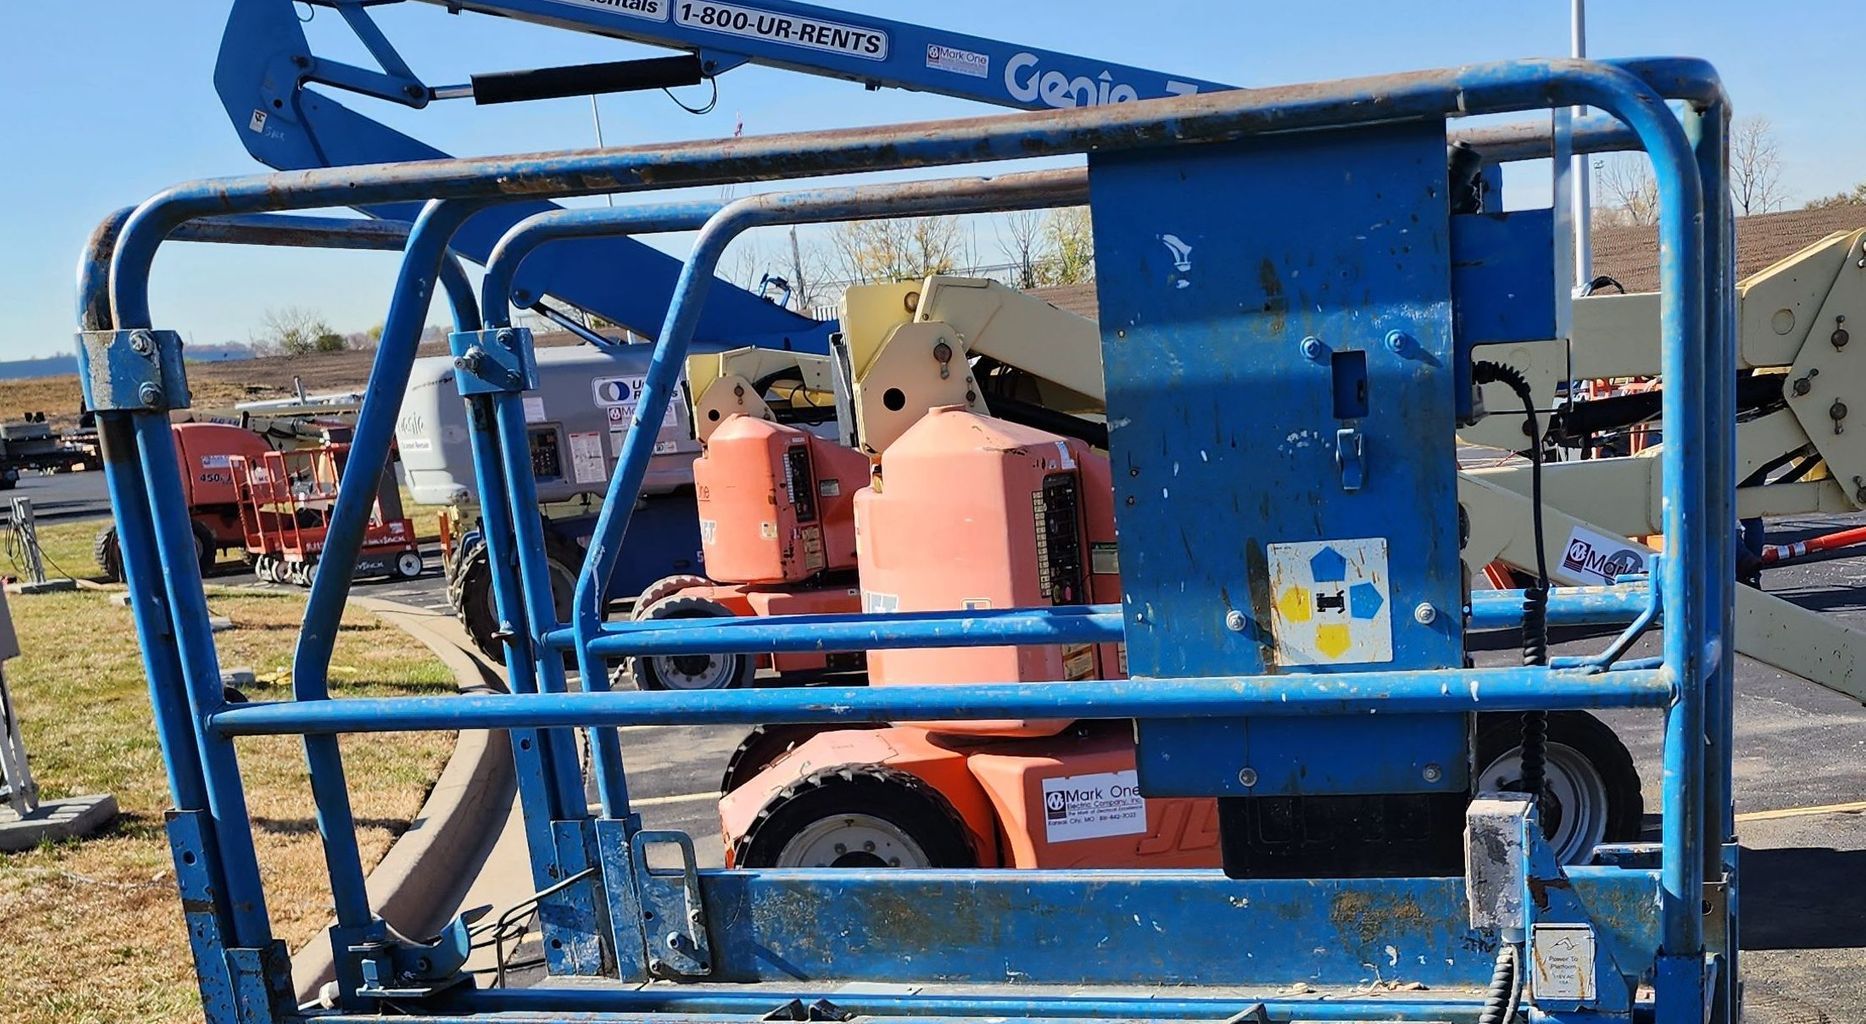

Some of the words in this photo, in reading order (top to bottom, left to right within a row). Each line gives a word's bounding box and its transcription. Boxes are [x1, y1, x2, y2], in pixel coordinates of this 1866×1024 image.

[590, 0, 658, 13] ntals
[681, 3, 881, 54] 1-800-UR-RENTS
[940, 47, 964, 60] Mark
[966, 53, 988, 65] One
[1066, 788, 1103, 803] Mark
[1110, 785, 1140, 799] One
